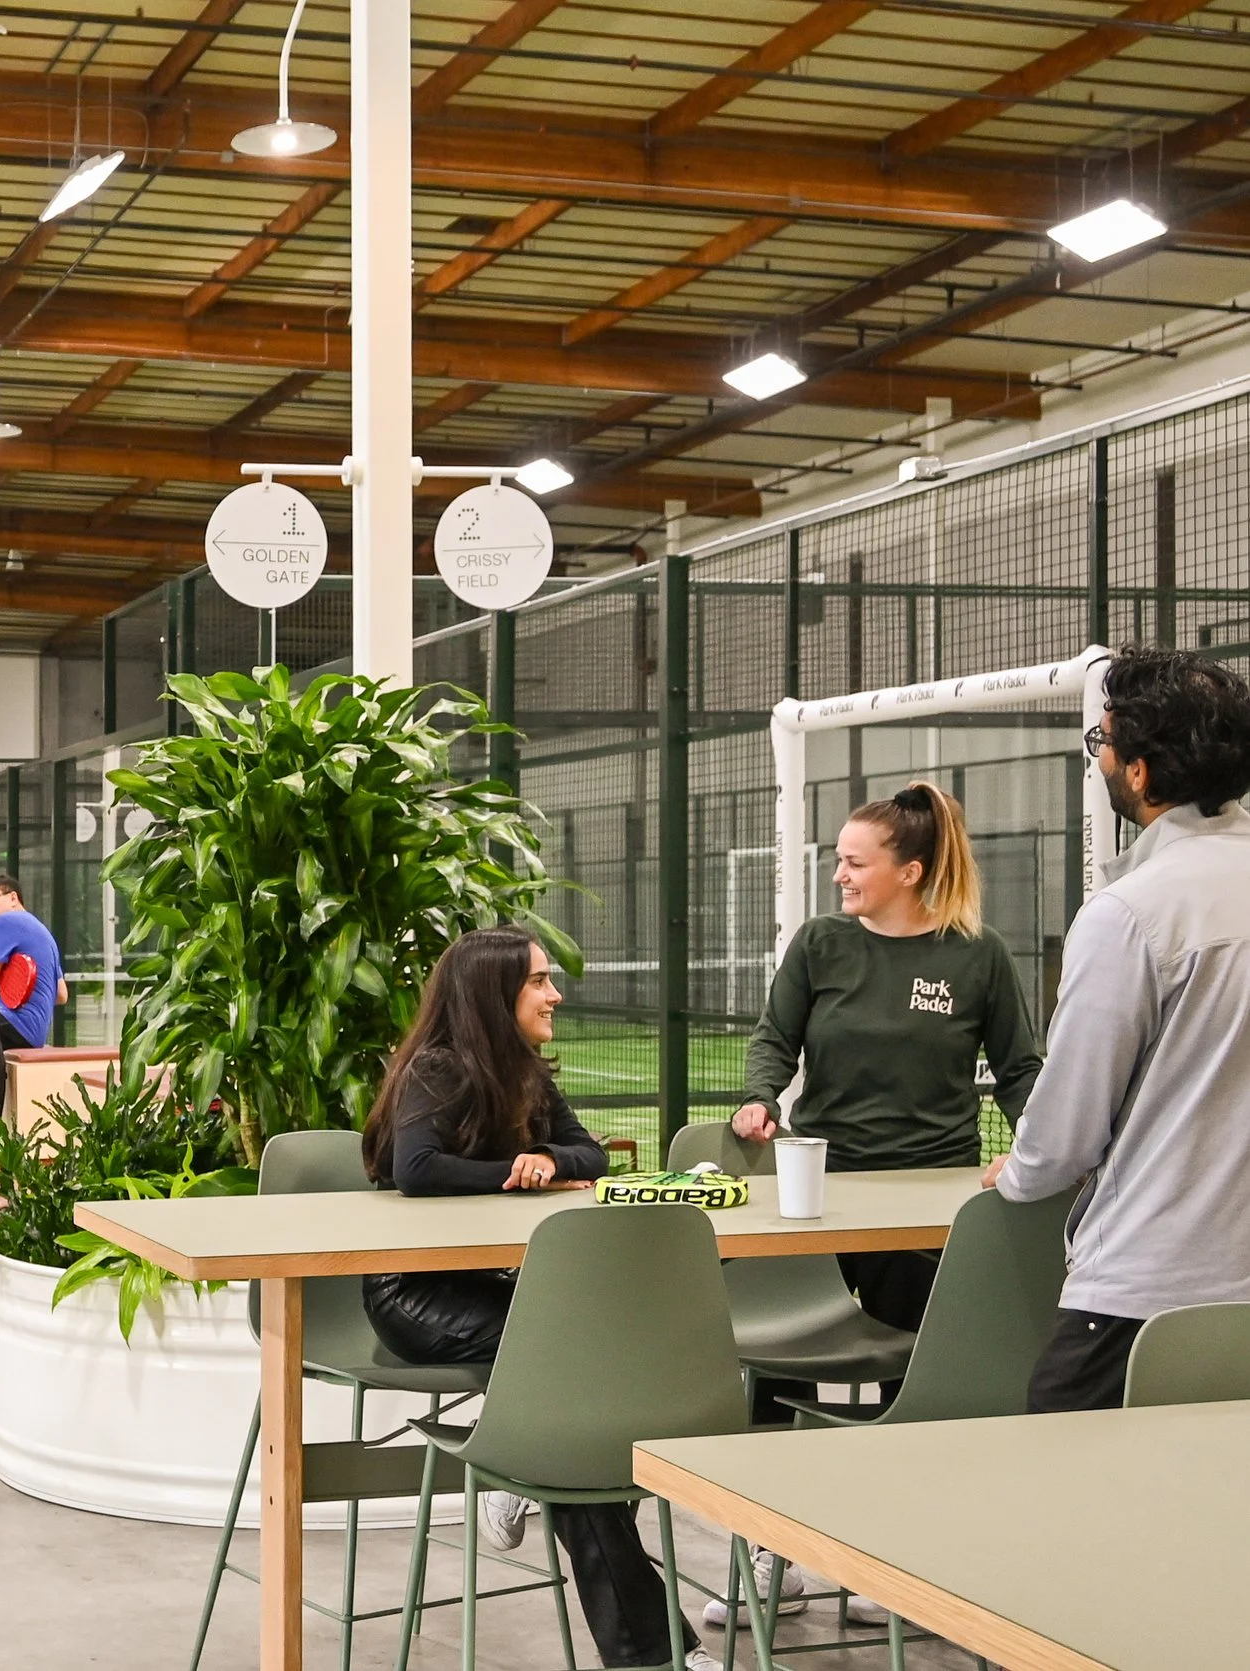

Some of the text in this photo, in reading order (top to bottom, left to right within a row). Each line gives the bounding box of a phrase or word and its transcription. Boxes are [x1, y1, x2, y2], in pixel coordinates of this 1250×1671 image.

[281, 502, 306, 536] 1
[457, 507, 481, 541] 2
[242, 548, 310, 565] GOLDEN
[456, 552, 512, 570] CRISSY
[265, 570, 310, 585] GATE
[457, 573, 500, 589] FIELD
[1083, 857, 1093, 892] Park
[911, 977, 951, 998] Park
[909, 994, 954, 1016] Padel
